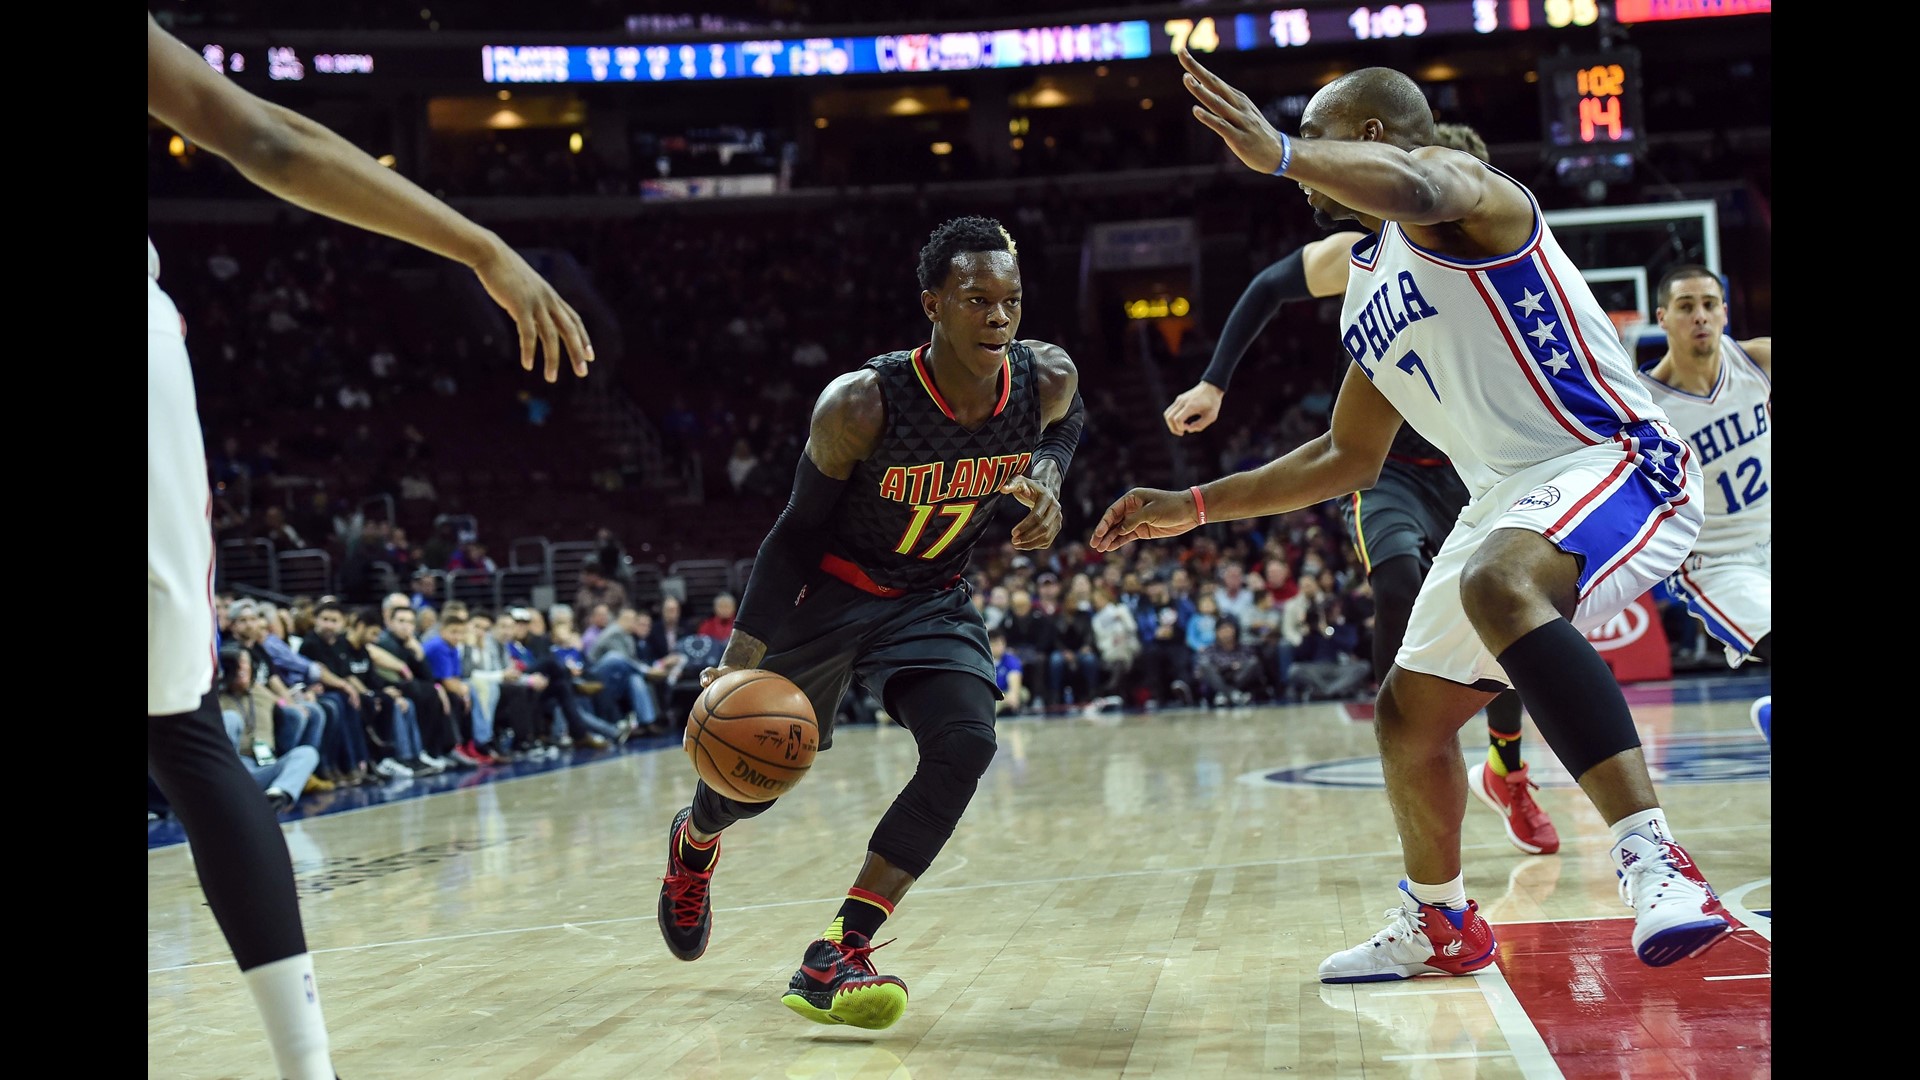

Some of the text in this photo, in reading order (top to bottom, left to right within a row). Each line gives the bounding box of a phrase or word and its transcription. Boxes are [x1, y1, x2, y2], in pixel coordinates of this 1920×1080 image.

[1164, 16, 1220, 54] 74
[1349, 4, 1427, 39] 1:03
[1579, 96, 1622, 141] 14
[1343, 270, 1439, 381] PHILA
[1395, 349, 1442, 404] 7
[1684, 403, 1767, 466] HILA
[1716, 456, 1769, 515] 12
[894, 501, 979, 561] 17
